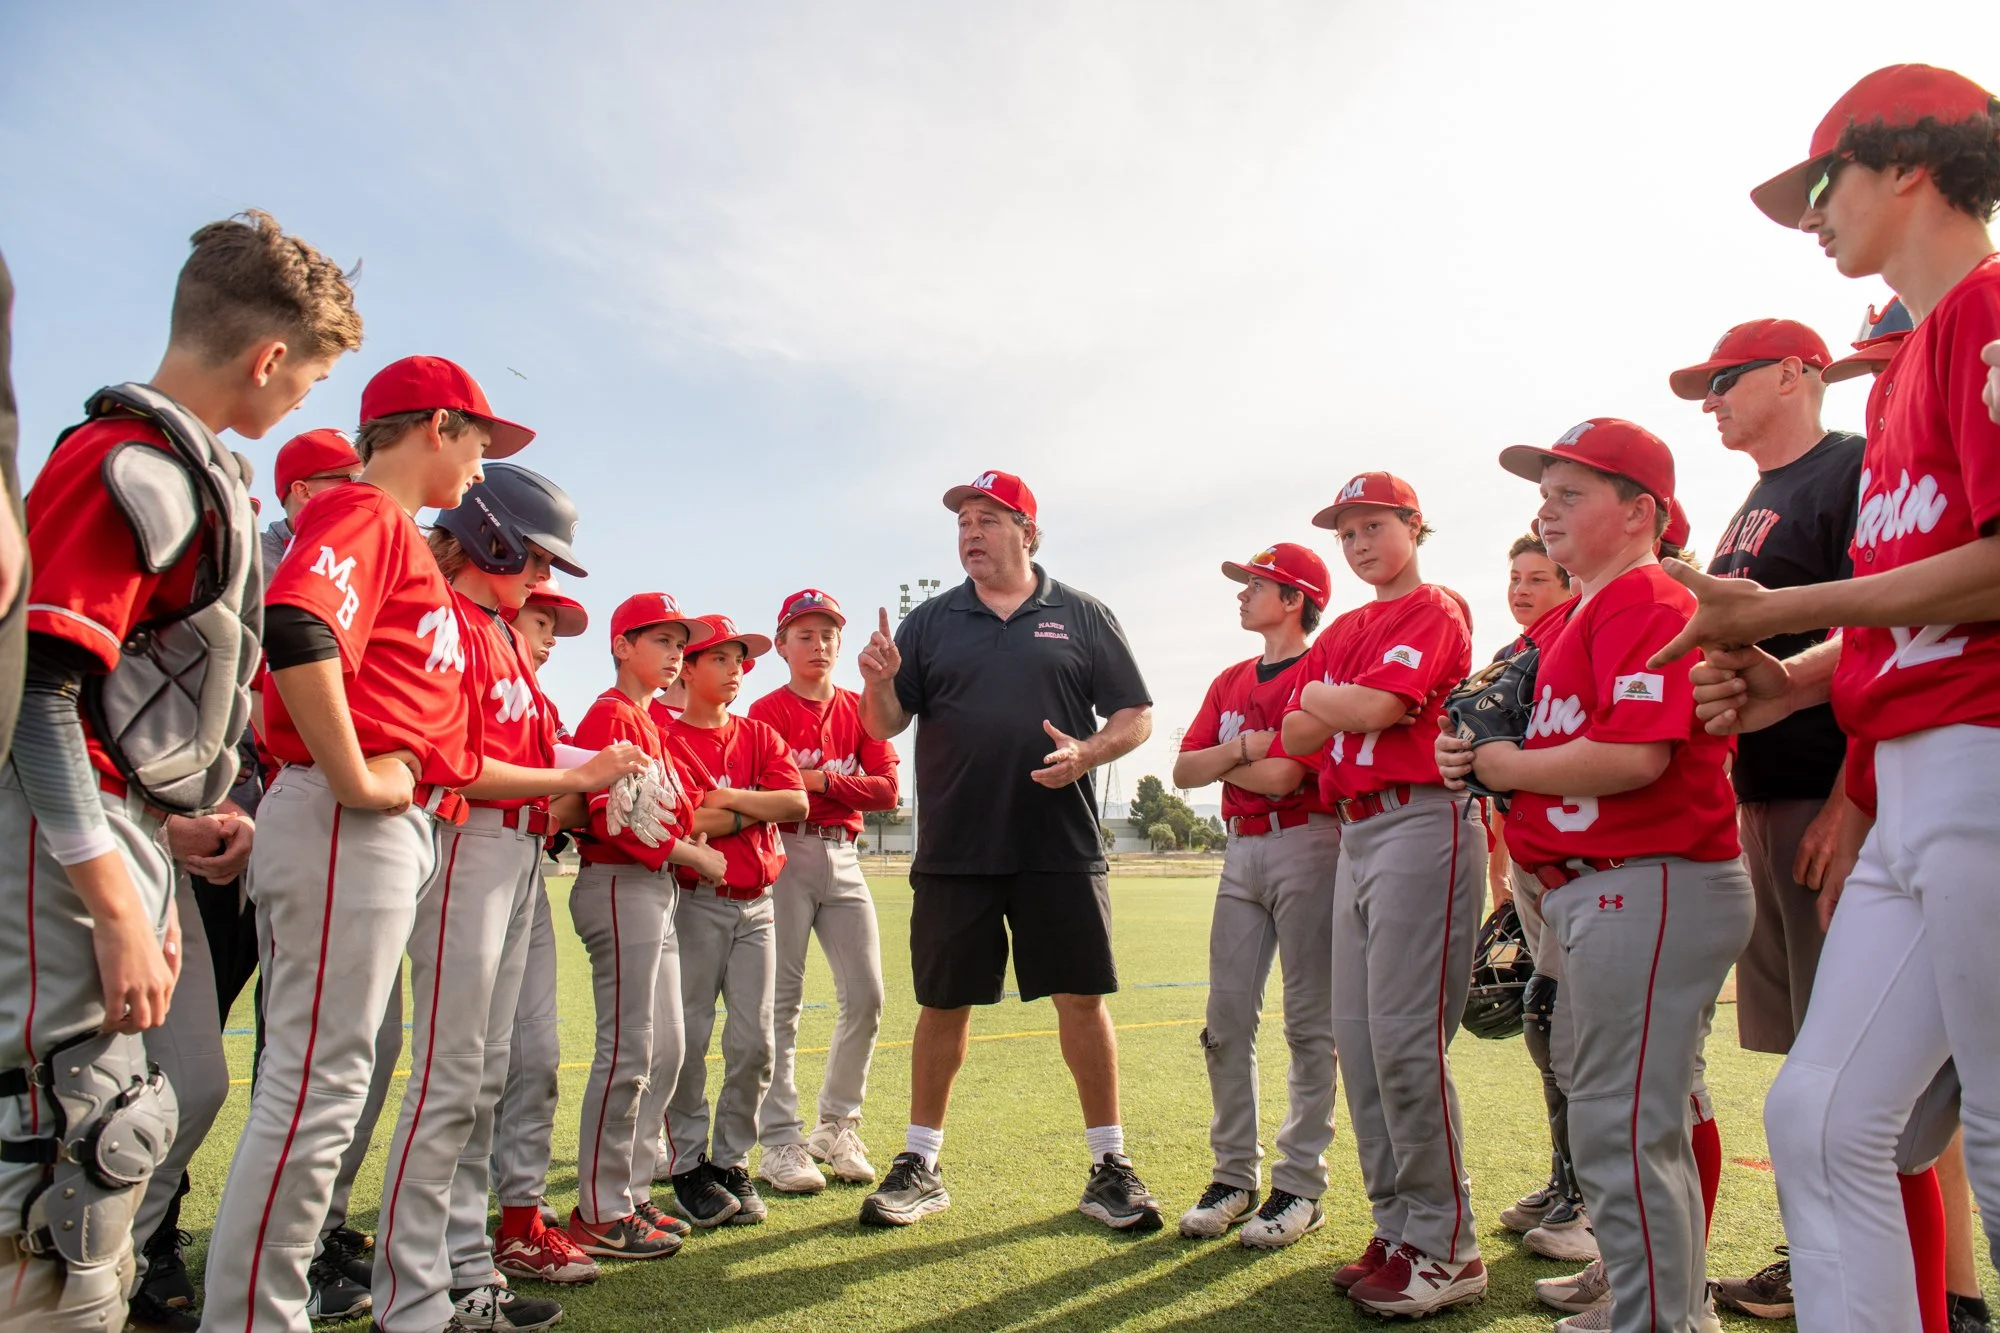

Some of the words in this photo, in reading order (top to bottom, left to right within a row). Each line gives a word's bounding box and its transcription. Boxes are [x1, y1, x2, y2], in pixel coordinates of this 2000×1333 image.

[972, 473, 998, 490] M
[1339, 477, 1367, 504] M
[1857, 467, 1948, 549] arin
[1715, 508, 1781, 558] ARIN
[659, 595, 685, 615] M
[1034, 631, 1070, 640] BASEBALL
[1038, 621, 1065, 631] MARIN
[1417, 1262, 1453, 1290] N
